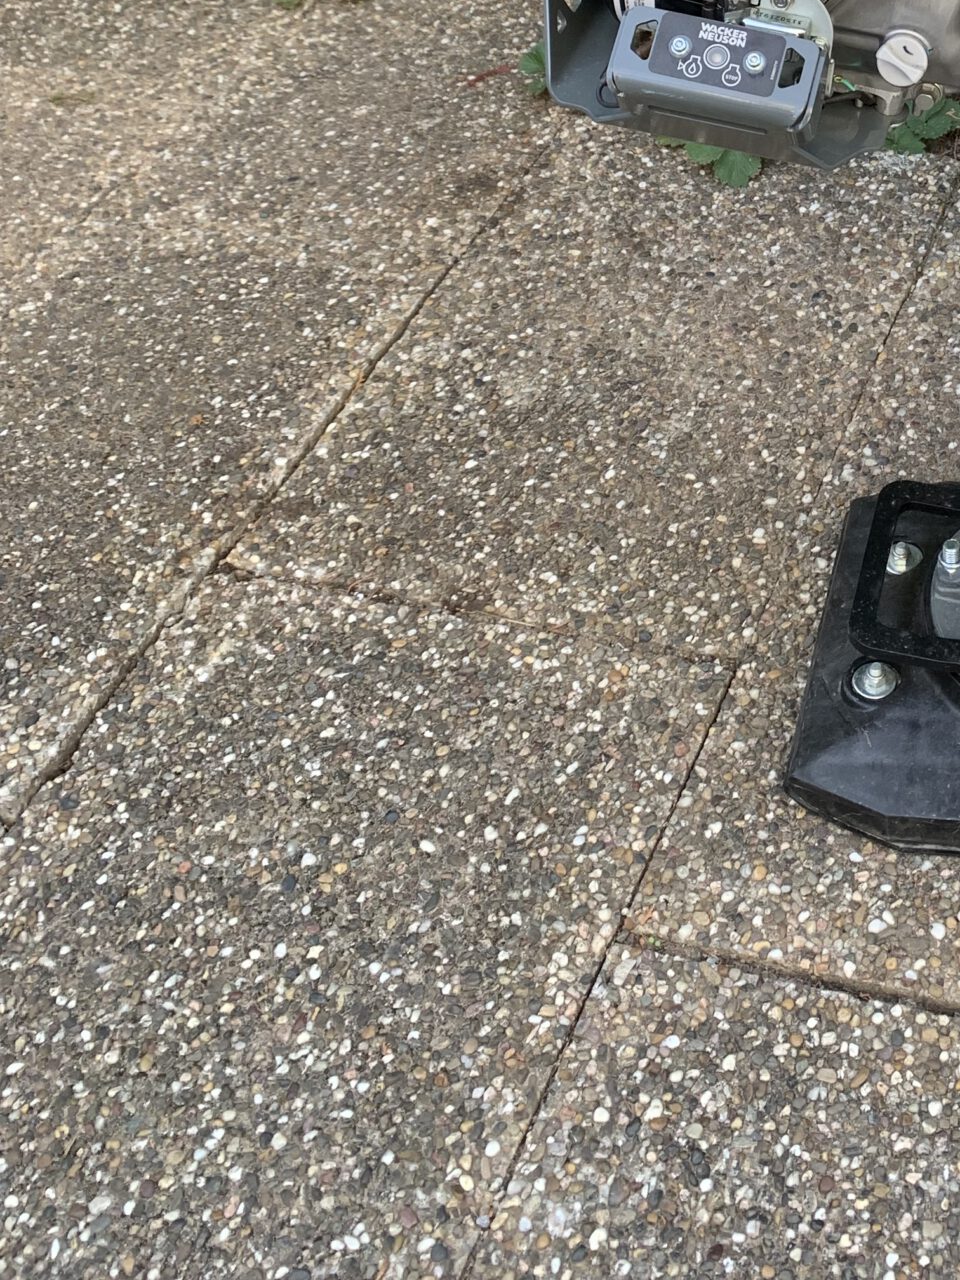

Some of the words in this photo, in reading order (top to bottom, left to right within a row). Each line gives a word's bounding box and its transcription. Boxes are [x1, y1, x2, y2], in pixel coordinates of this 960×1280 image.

[698, 30, 747, 48] NEUSON
[701, 22, 748, 40] WACKER
[725, 74, 739, 82] STOP
